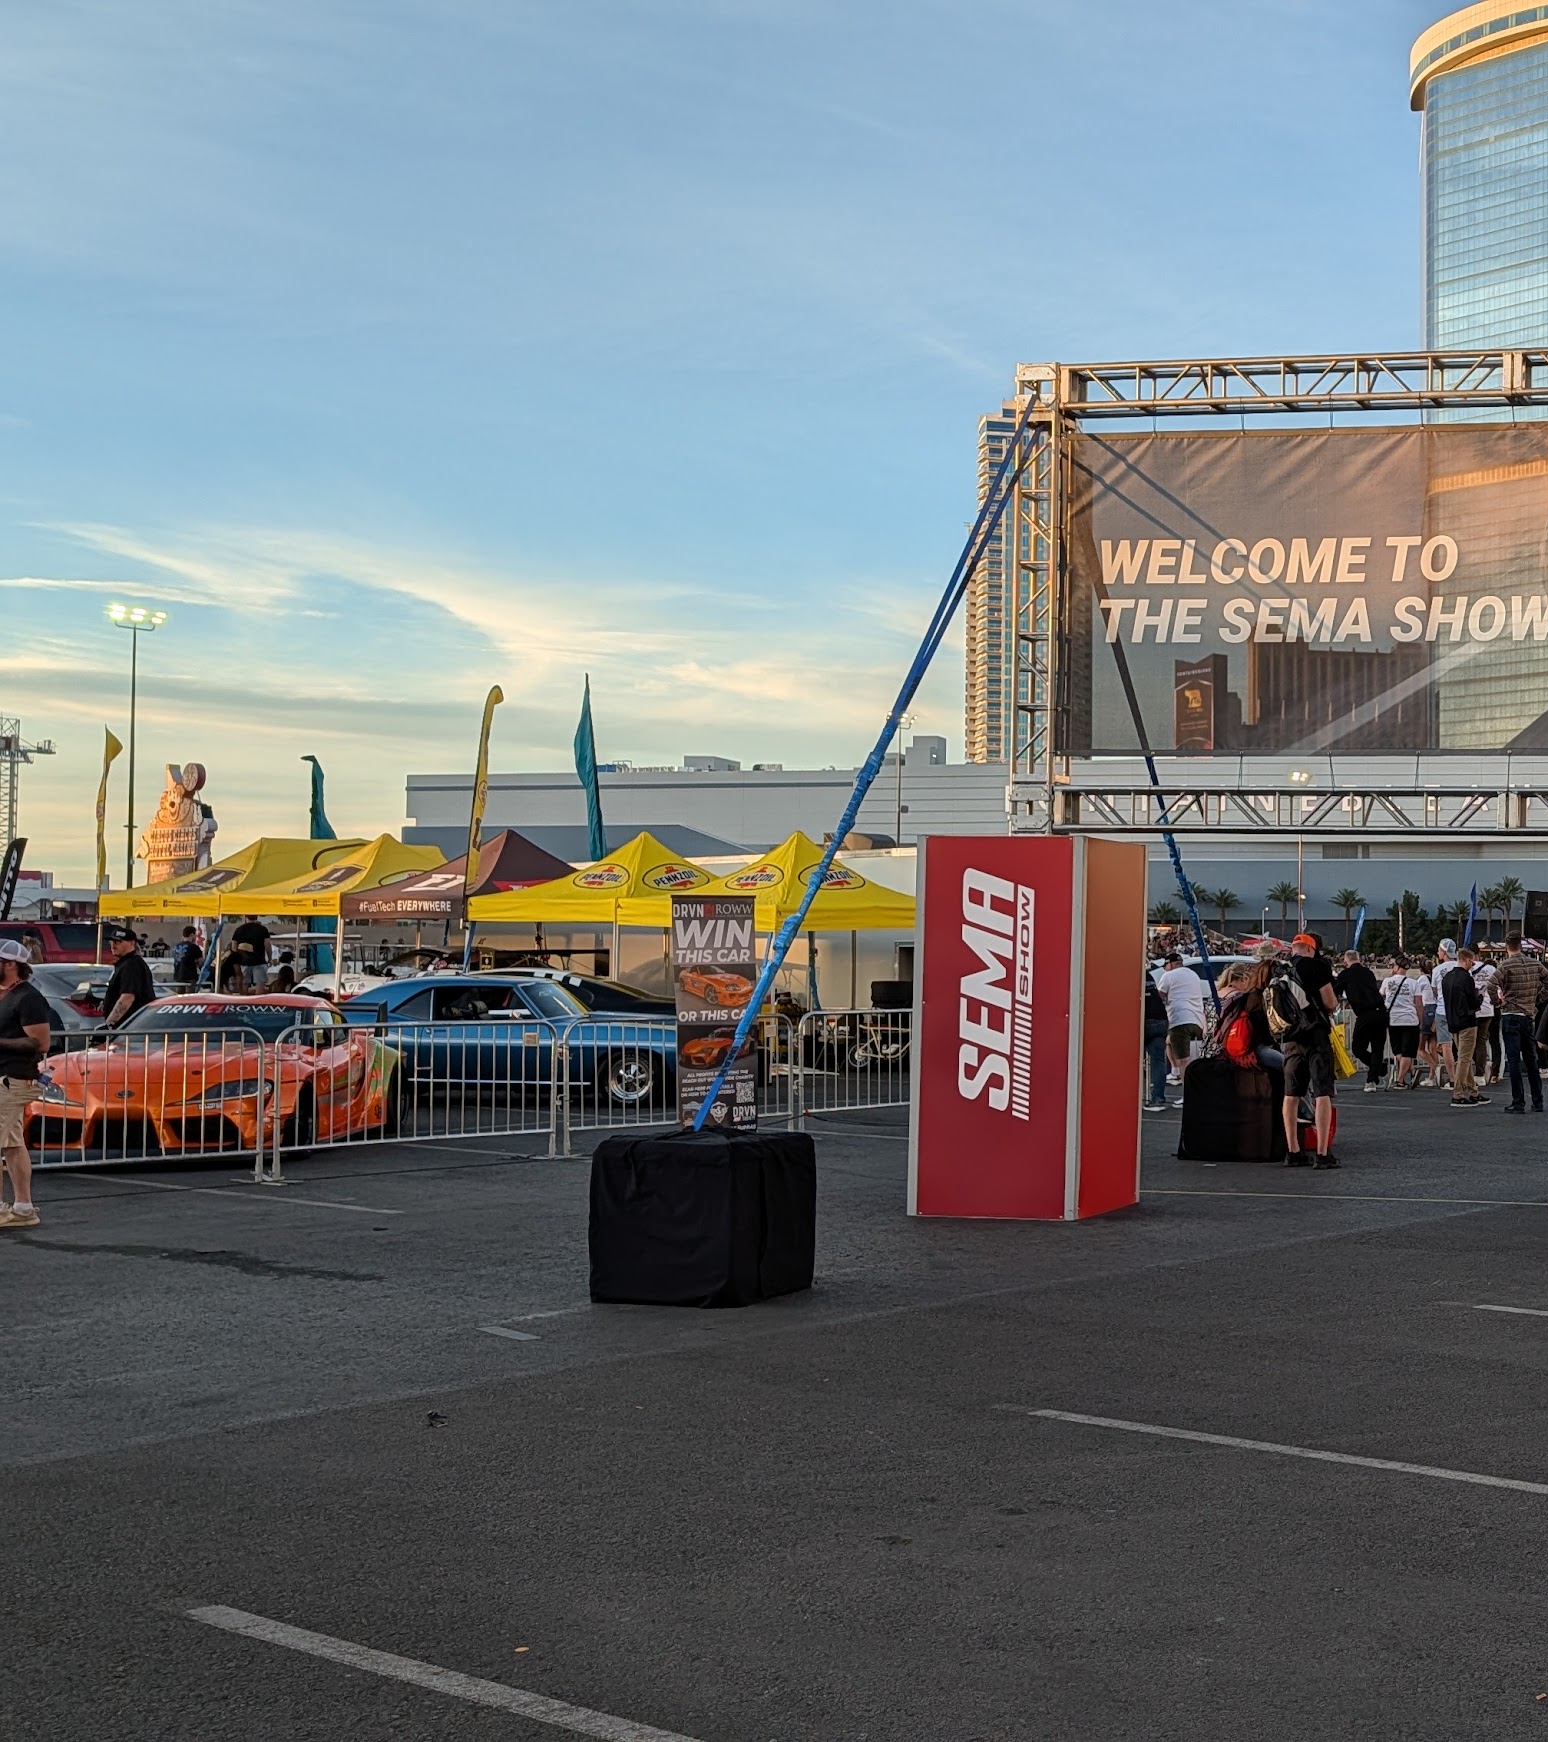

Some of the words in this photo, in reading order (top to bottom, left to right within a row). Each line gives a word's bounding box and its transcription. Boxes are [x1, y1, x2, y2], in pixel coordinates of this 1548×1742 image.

[1099, 535, 1367, 585] WELCOME
[1386, 534, 1458, 582] TO
[1099, 598, 1207, 644] THE
[1218, 596, 1373, 643] SEMA
[652, 870, 699, 887] PENNZOIL
[358, 900, 396, 913] #FuelTech
[397, 900, 452, 913] EVERYWHERE
[673, 903, 704, 918] DRVN
[715, 903, 753, 914] ROWW
[675, 919, 753, 949] WIN
[676, 949, 713, 964] THIS
[717, 949, 750, 963] CAR
[957, 867, 1015, 1111] SEMA
[1018, 890, 1032, 998] SHOW
[156, 1004, 208, 1014] DRVN
[678, 1011, 698, 1022] OR
[700, 1010, 731, 1022] THIS
[733, 1009, 748, 1020] CA
[733, 1105, 756, 1117] DRVN
